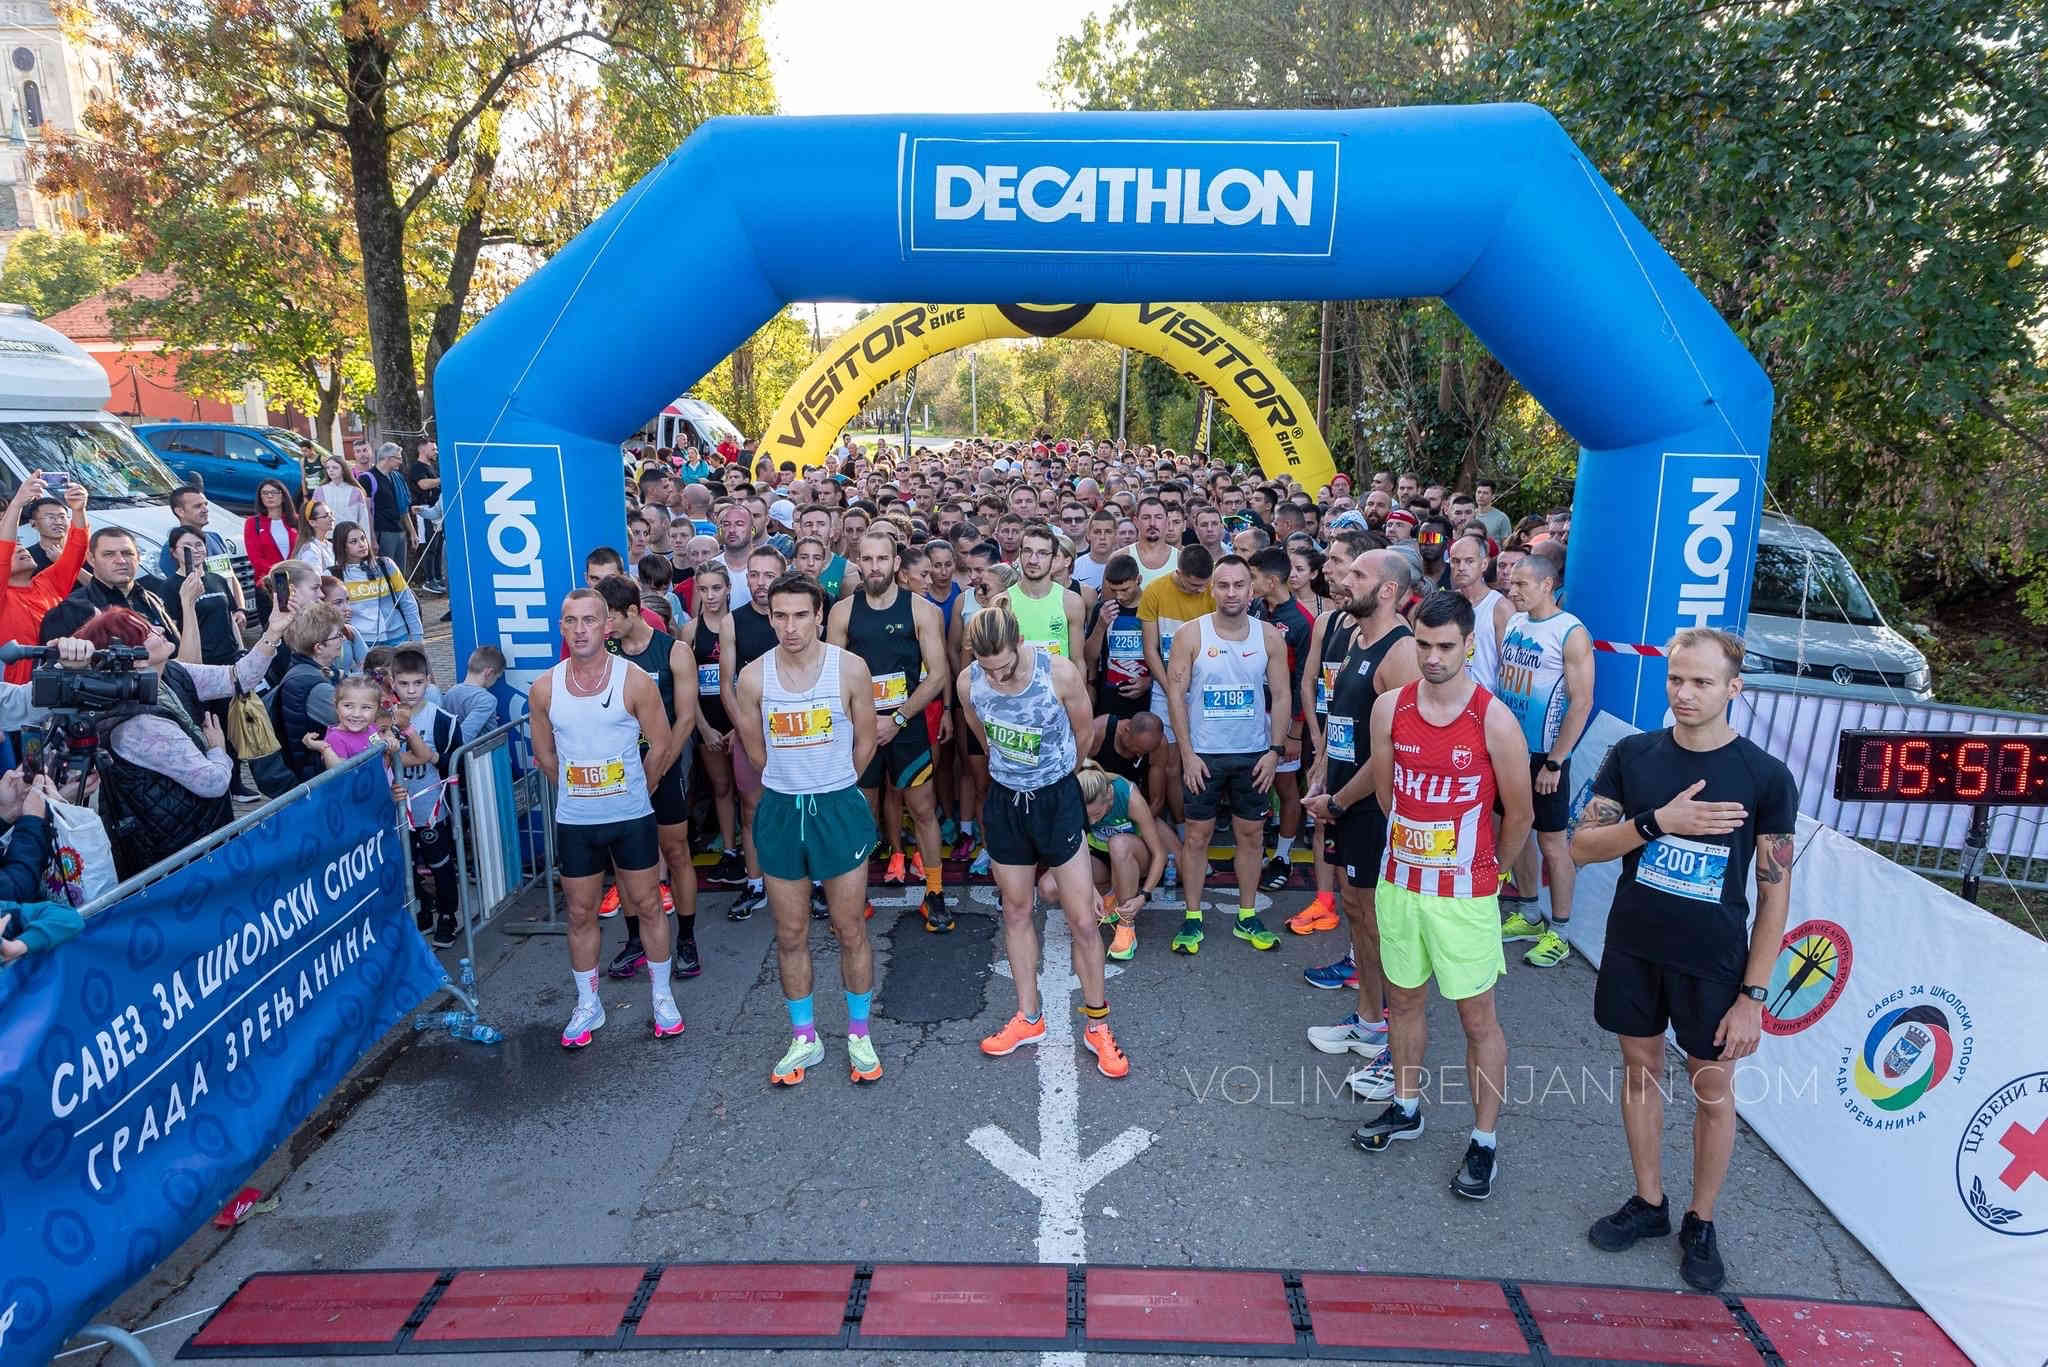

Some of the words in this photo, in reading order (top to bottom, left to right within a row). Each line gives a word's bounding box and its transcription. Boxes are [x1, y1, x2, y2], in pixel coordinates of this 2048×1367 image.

[935, 164, 1314, 226] DECATHLON
[930, 307, 965, 330] BIKE
[1276, 431, 1301, 466] BIKE
[1213, 690, 1245, 706] 2198
[1405, 828, 1435, 851] 208
[1655, 844, 1708, 878] 2001
[51, 1004, 149, 1120] САВЕЗ
[152, 968, 193, 1032] ЗА
[197, 879, 319, 999] ШКОЛСКИ
[323, 829, 385, 899] СПОРТ
[87, 1062, 209, 1190] ГРАДА
[226, 917, 377, 1073] ЗРЕЊАНИНА
[1867, 989, 1904, 1019] САВЕЗ
[1910, 985, 1924, 995] ЗА
[1930, 985, 1974, 1032] ШКОЛСКИ
[1953, 1037, 1974, 1084] СПОРТ
[1838, 1047, 1852, 1097] ГРАДА
[1845, 1098, 1927, 1131] ЗРЕЊАНИНА
[1964, 1082, 2028, 1153] ЦРВЕНИ
